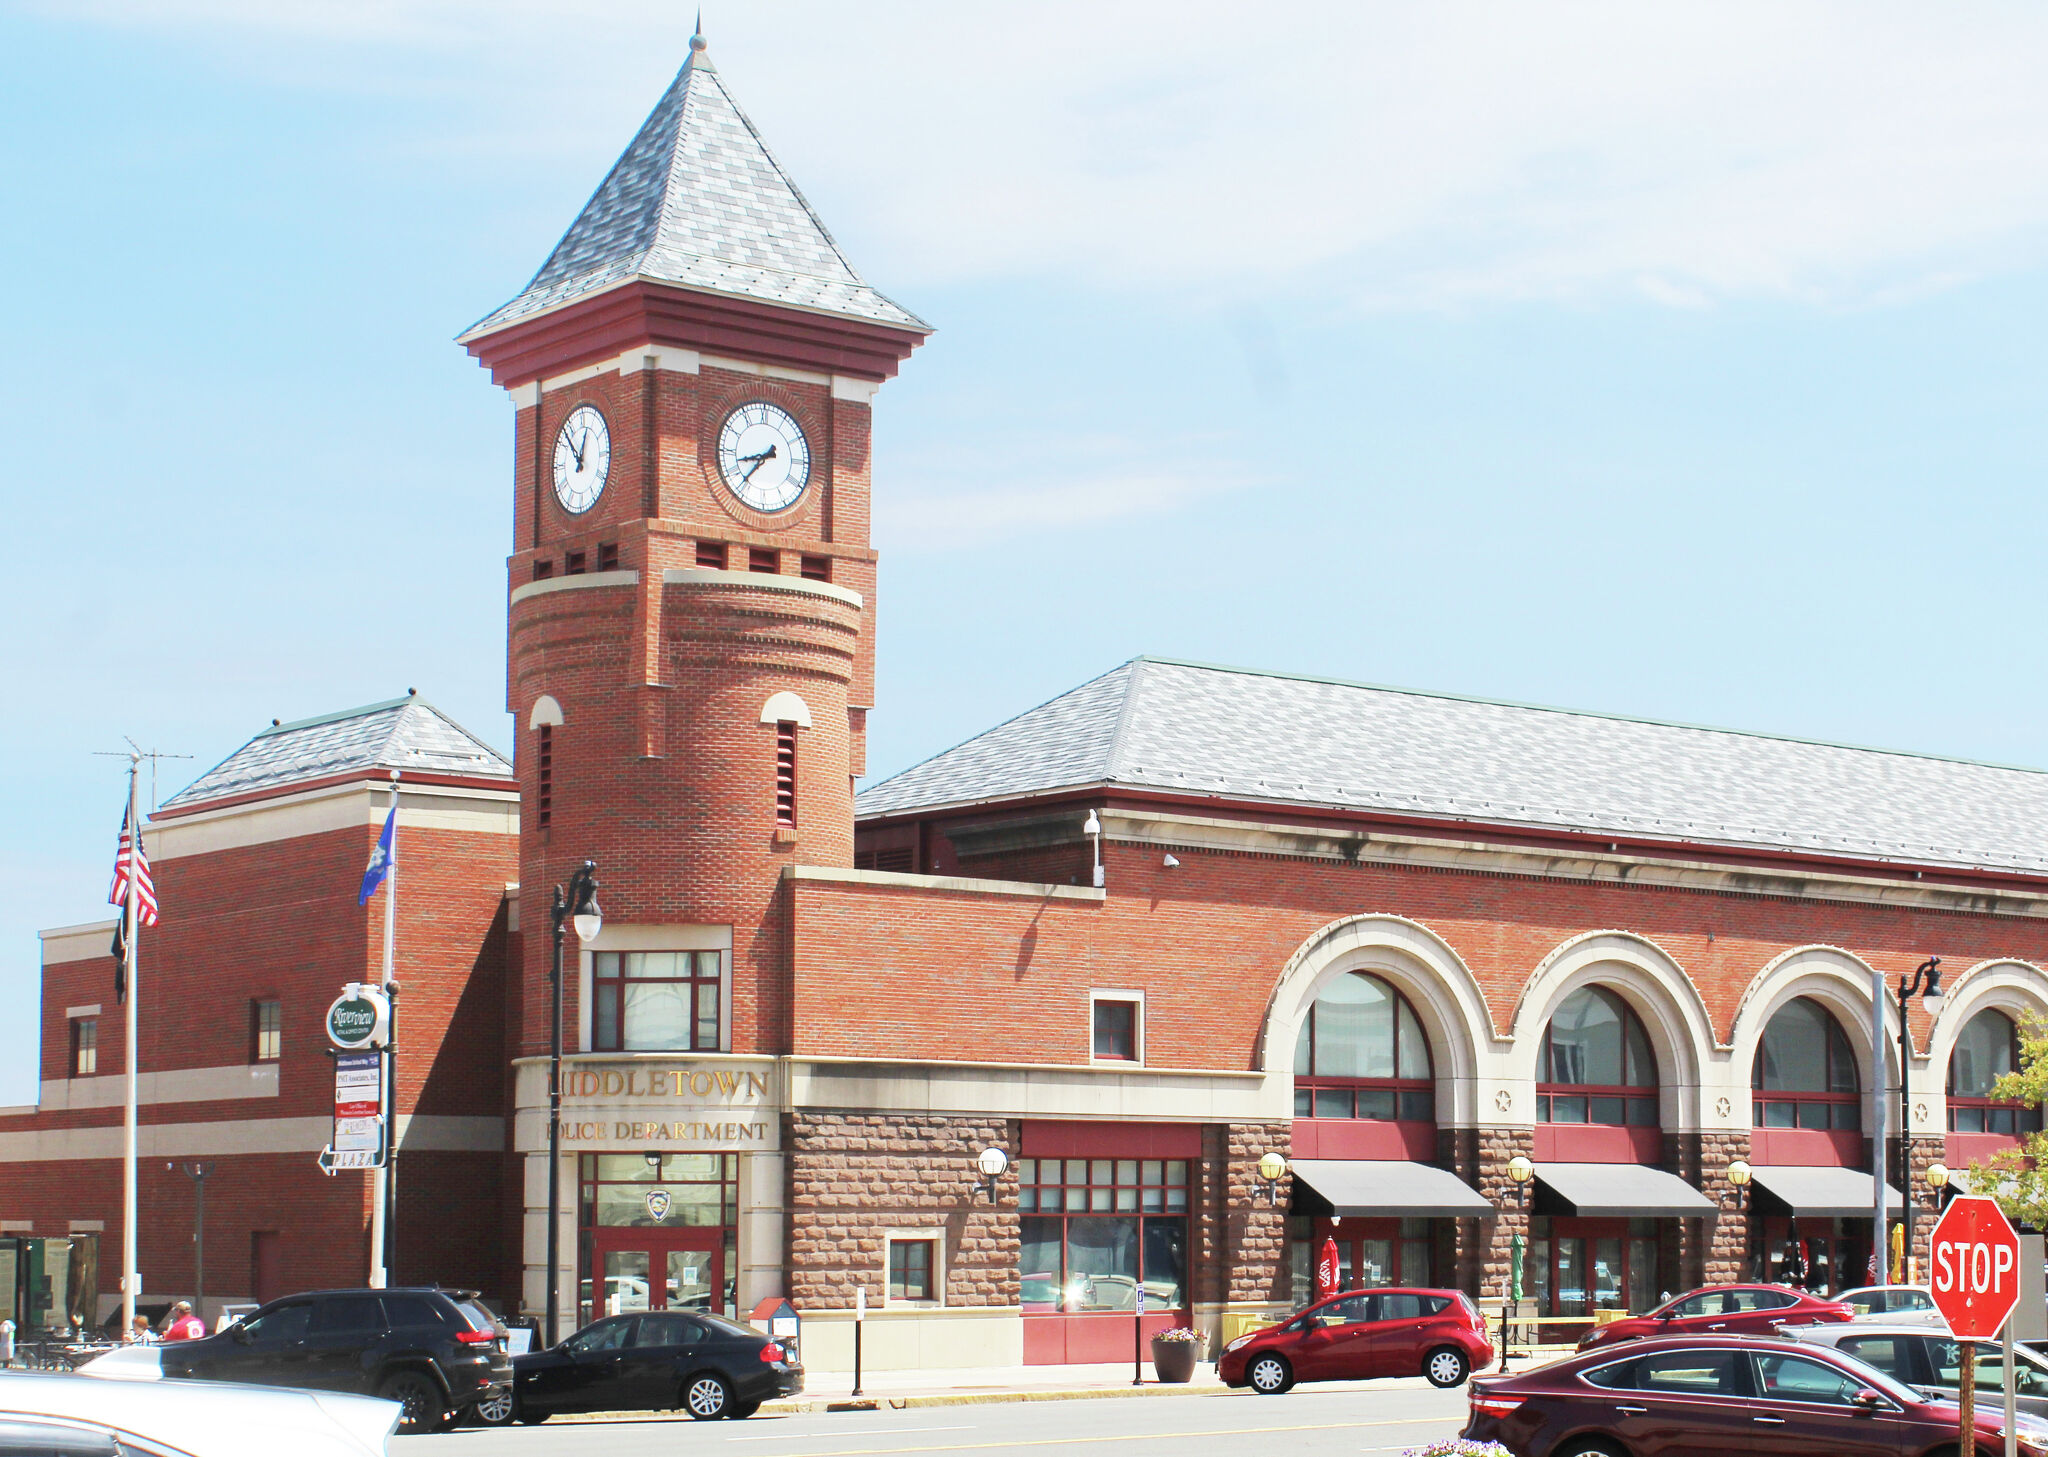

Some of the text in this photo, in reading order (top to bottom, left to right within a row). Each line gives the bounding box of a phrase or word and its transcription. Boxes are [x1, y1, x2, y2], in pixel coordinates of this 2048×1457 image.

[334, 1007, 374, 1026] Riverview
[614, 1121, 769, 1141] DEPARTMENT
[334, 1153, 373, 1166] PLAZA
[1936, 1241, 2013, 1294] STOP
